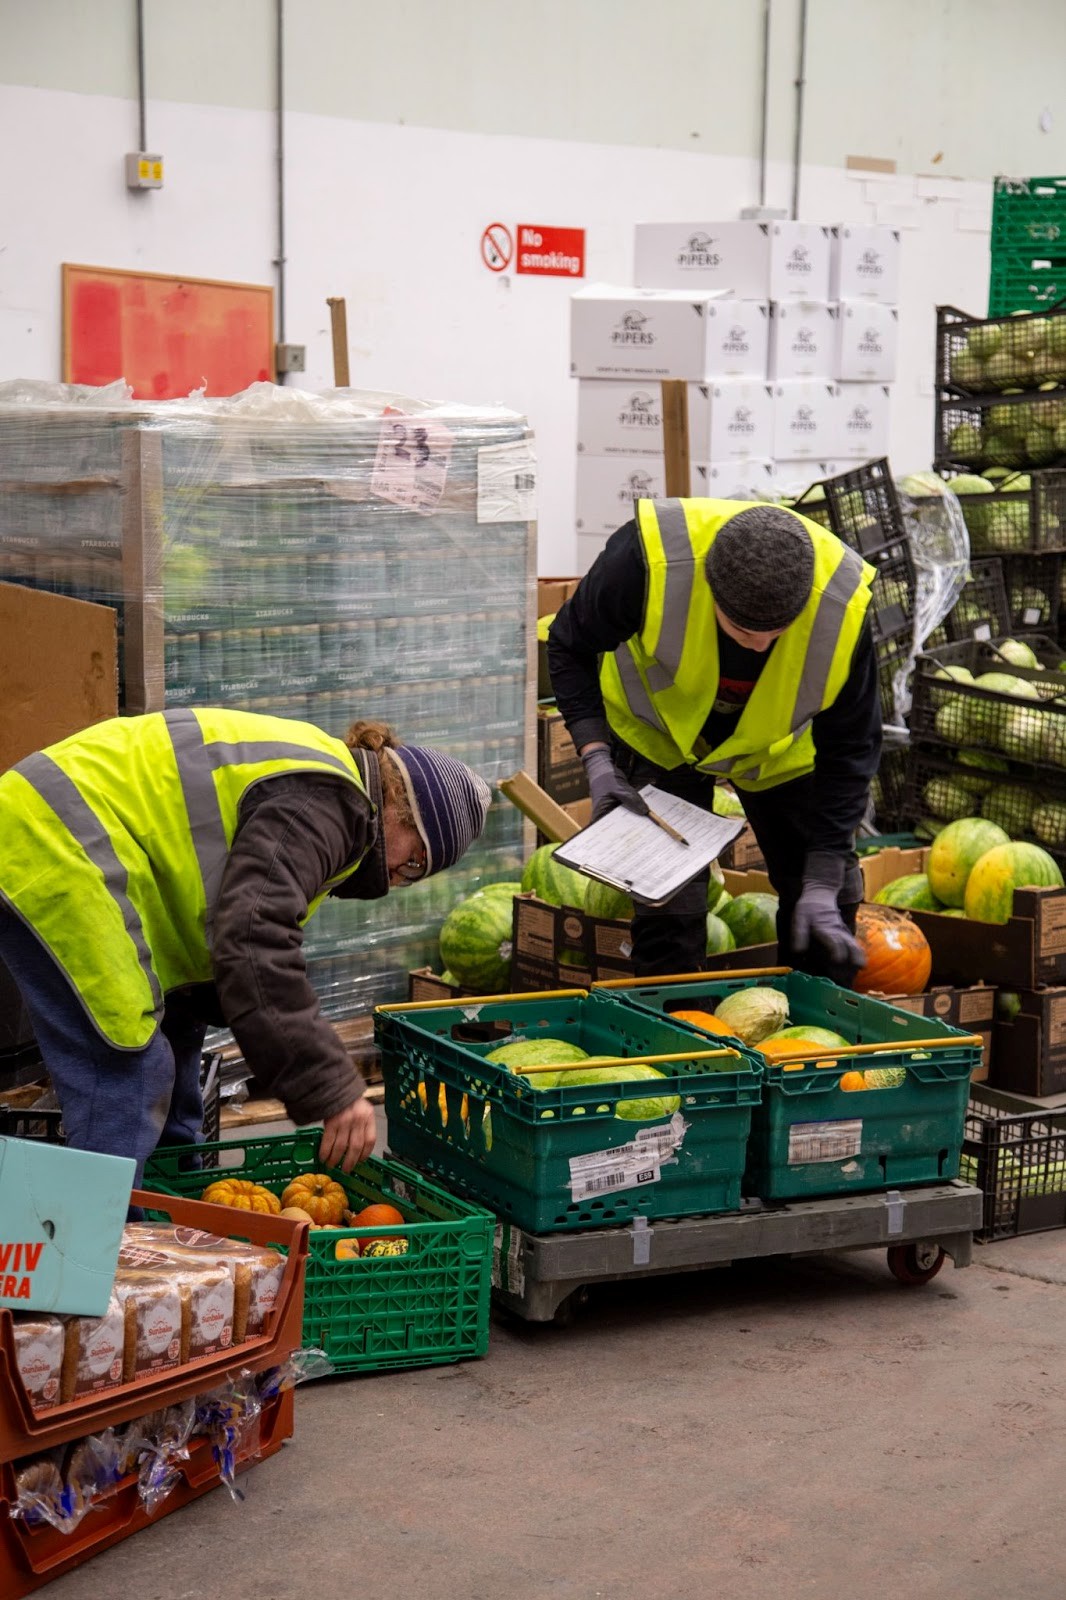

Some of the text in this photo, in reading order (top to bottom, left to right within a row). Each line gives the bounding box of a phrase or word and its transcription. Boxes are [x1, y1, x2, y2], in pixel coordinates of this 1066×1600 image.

[521, 229, 543, 247] No
[521, 252, 580, 273] smoking
[679, 253, 720, 267] PIPERS
[612, 332, 654, 345] PIPERS
[620, 413, 661, 426] PIPERS
[80, 539, 120, 548] STARBUCKS
[168, 613, 210, 622] STARBUCKS
[256, 608, 294, 617] STARBUCKS
[220, 680, 259, 691] STARBUCKS
[281, 676, 318, 686] STARBUCKS
[638, 1171, 652, 1181] E59
[202, 1313, 224, 1323] Sunbake
[148, 1326, 173, 1337] Sunbake
[90, 1346, 115, 1357] Sunbake
[22, 1363, 51, 1375] Sunbake
